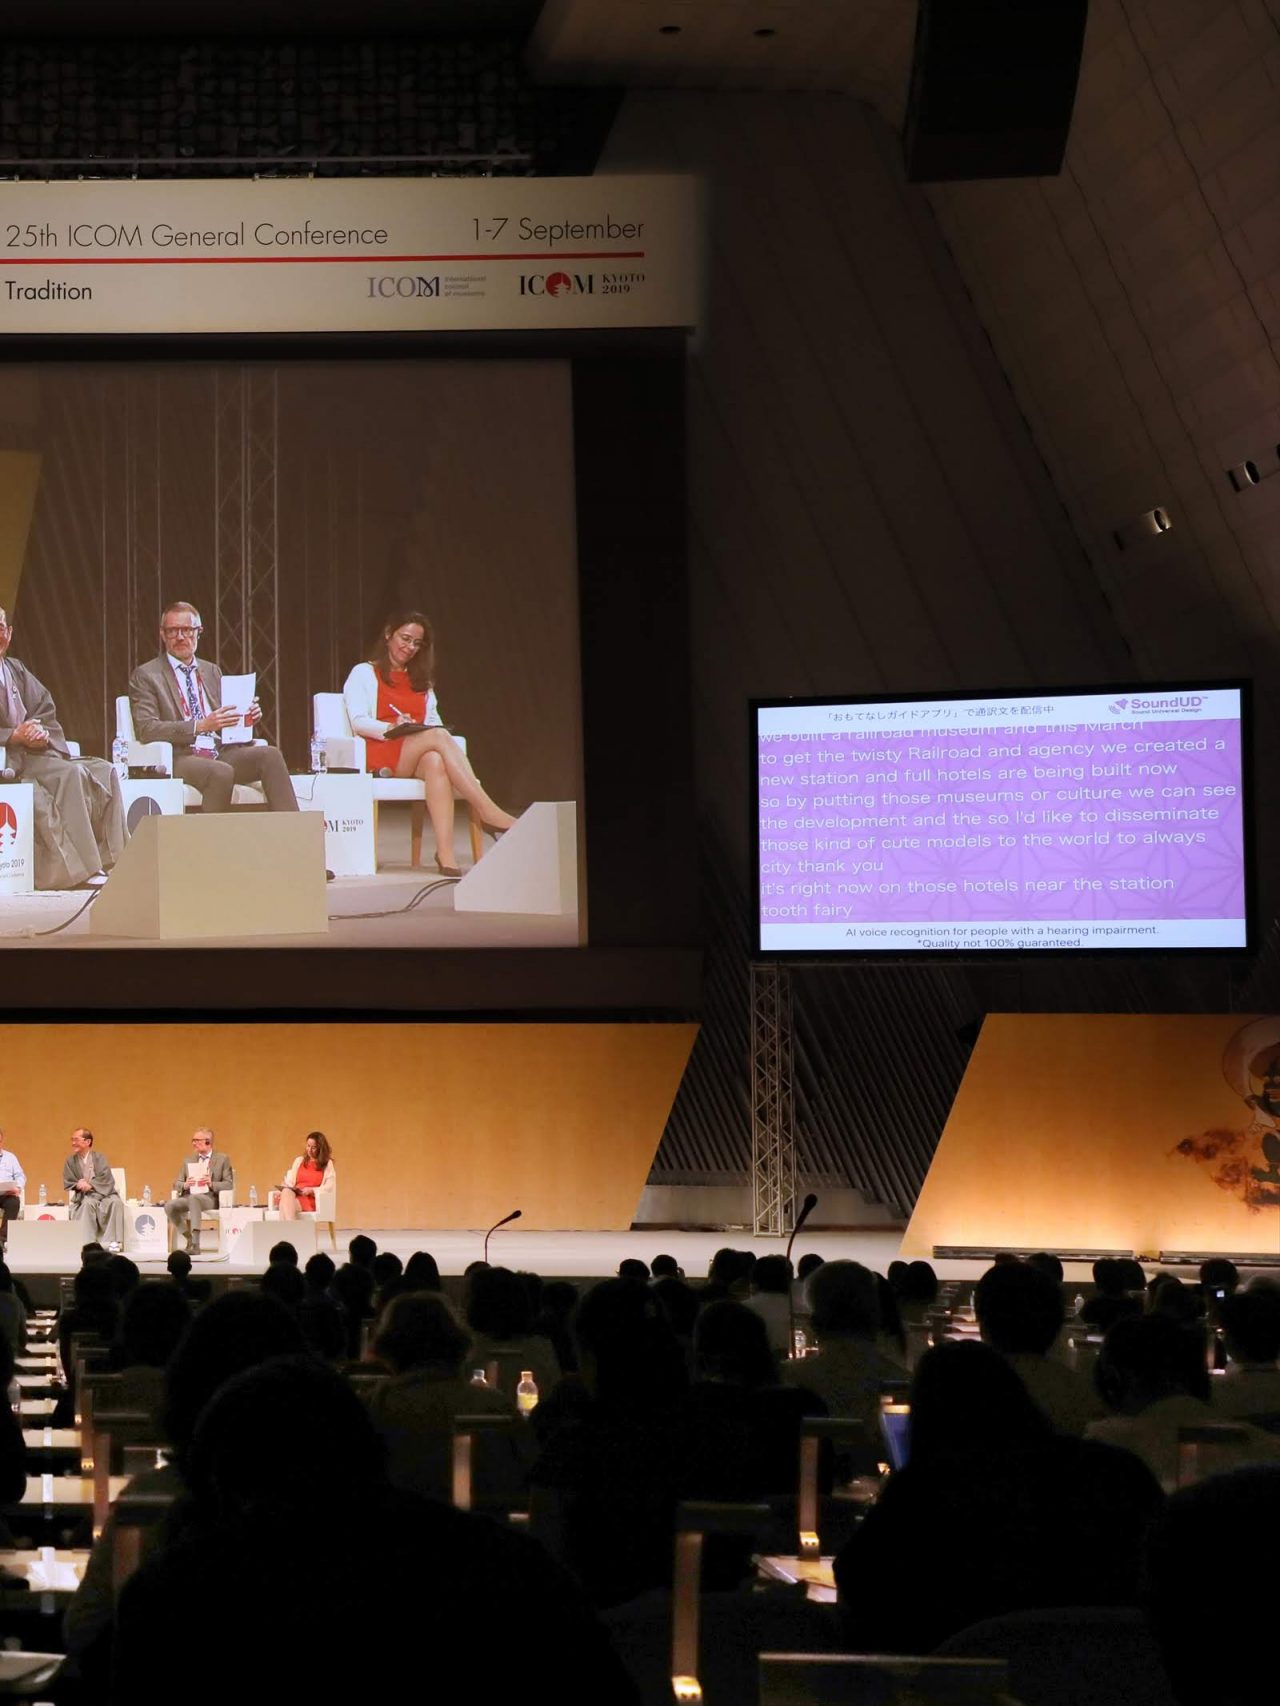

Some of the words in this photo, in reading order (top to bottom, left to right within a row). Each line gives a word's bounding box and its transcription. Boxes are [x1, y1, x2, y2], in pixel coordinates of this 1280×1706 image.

[6, 223, 58, 248] 25th
[67, 222, 143, 248] ICOM
[151, 221, 245, 248] General
[253, 220, 389, 247] Conference
[472, 217, 509, 243] 1-7
[518, 215, 644, 244] September
[368, 276, 441, 298] ICOM
[602, 273, 646, 284] KYOTO
[602, 284, 631, 295] 2019
[5, 279, 93, 301] Tradition
[759, 752, 777, 765] to
[783, 751, 811, 767] get
[817, 750, 845, 763] the
[851, 749, 902, 766] twisty
[908, 745, 981, 761] Railroad
[988, 744, 1022, 758] and
[1028, 744, 1095, 759] agency
[1101, 742, 1127, 754] we
[1134, 738, 1207, 753] created
[1215, 740, 1226, 751] a
[759, 774, 794, 786] new
[800, 771, 859, 785] station
[865, 769, 898, 784] and
[904, 769, 931, 782] full
[937, 767, 992, 782] hotels
[998, 767, 1027, 780] are
[1034, 764, 1085, 781] being
[1091, 763, 1132, 777] built
[1138, 764, 1178, 775] now
[760, 797, 780, 809] so
[786, 794, 807, 810] by
[813, 793, 875, 810] putting
[881, 792, 931, 806] those
[937, 790, 1024, 803] museums
[1030, 790, 1050, 801] or
[1056, 786, 1122, 801] culture
[1129, 787, 1154, 798] we
[1161, 786, 1196, 798] can
[1203, 785, 1237, 797] see
[760, 816, 788, 830] the
[793, 813, 907, 831] development
[913, 812, 946, 826] and
[952, 811, 982, 825] the
[988, 814, 1009, 825] so
[1016, 810, 1035, 824] I'd
[1042, 809, 1073, 823] like
[1079, 810, 1098, 822] to
[1104, 807, 1220, 823] disseminate
[760, 838, 809, 852] those
[815, 837, 851, 851] kind
[857, 837, 875, 850] of
[881, 836, 921, 849] cute
[927, 834, 992, 848] models
[998, 834, 1017, 847] to
[1023, 833, 1053, 846] the
[1059, 831, 1110, 845] world
[1117, 832, 1136, 844] to
[1143, 830, 1207, 846] always
[11, 858, 24, 868] 2019
[761, 860, 792, 876] city
[798, 859, 846, 873] thank
[852, 861, 884, 874] you
[761, 882, 785, 895] it's
[791, 881, 832, 898] right
[837, 883, 873, 895] now
[879, 883, 901, 894] on
[908, 880, 958, 894] those
[963, 878, 1019, 893] hotels
[1025, 879, 1066, 892] near
[1072, 877, 1103, 891] the
[1109, 876, 1175, 890] station
[761, 903, 807, 917] tooth
[814, 903, 853, 918] fairy
[846, 928, 857, 937] AI
[859, 928, 888, 937] voice
[890, 927, 950, 938] recognition
[953, 927, 968, 936] for
[970, 926, 1009, 938] people
[1011, 926, 1035, 936] with
[1047, 925, 1090, 937] hearing
[1092, 925, 1160, 937] impairment.
[963, 939, 981, 948] not
[984, 939, 1015, 948] 100%
[1017, 938, 1084, 949] guaranteed.
